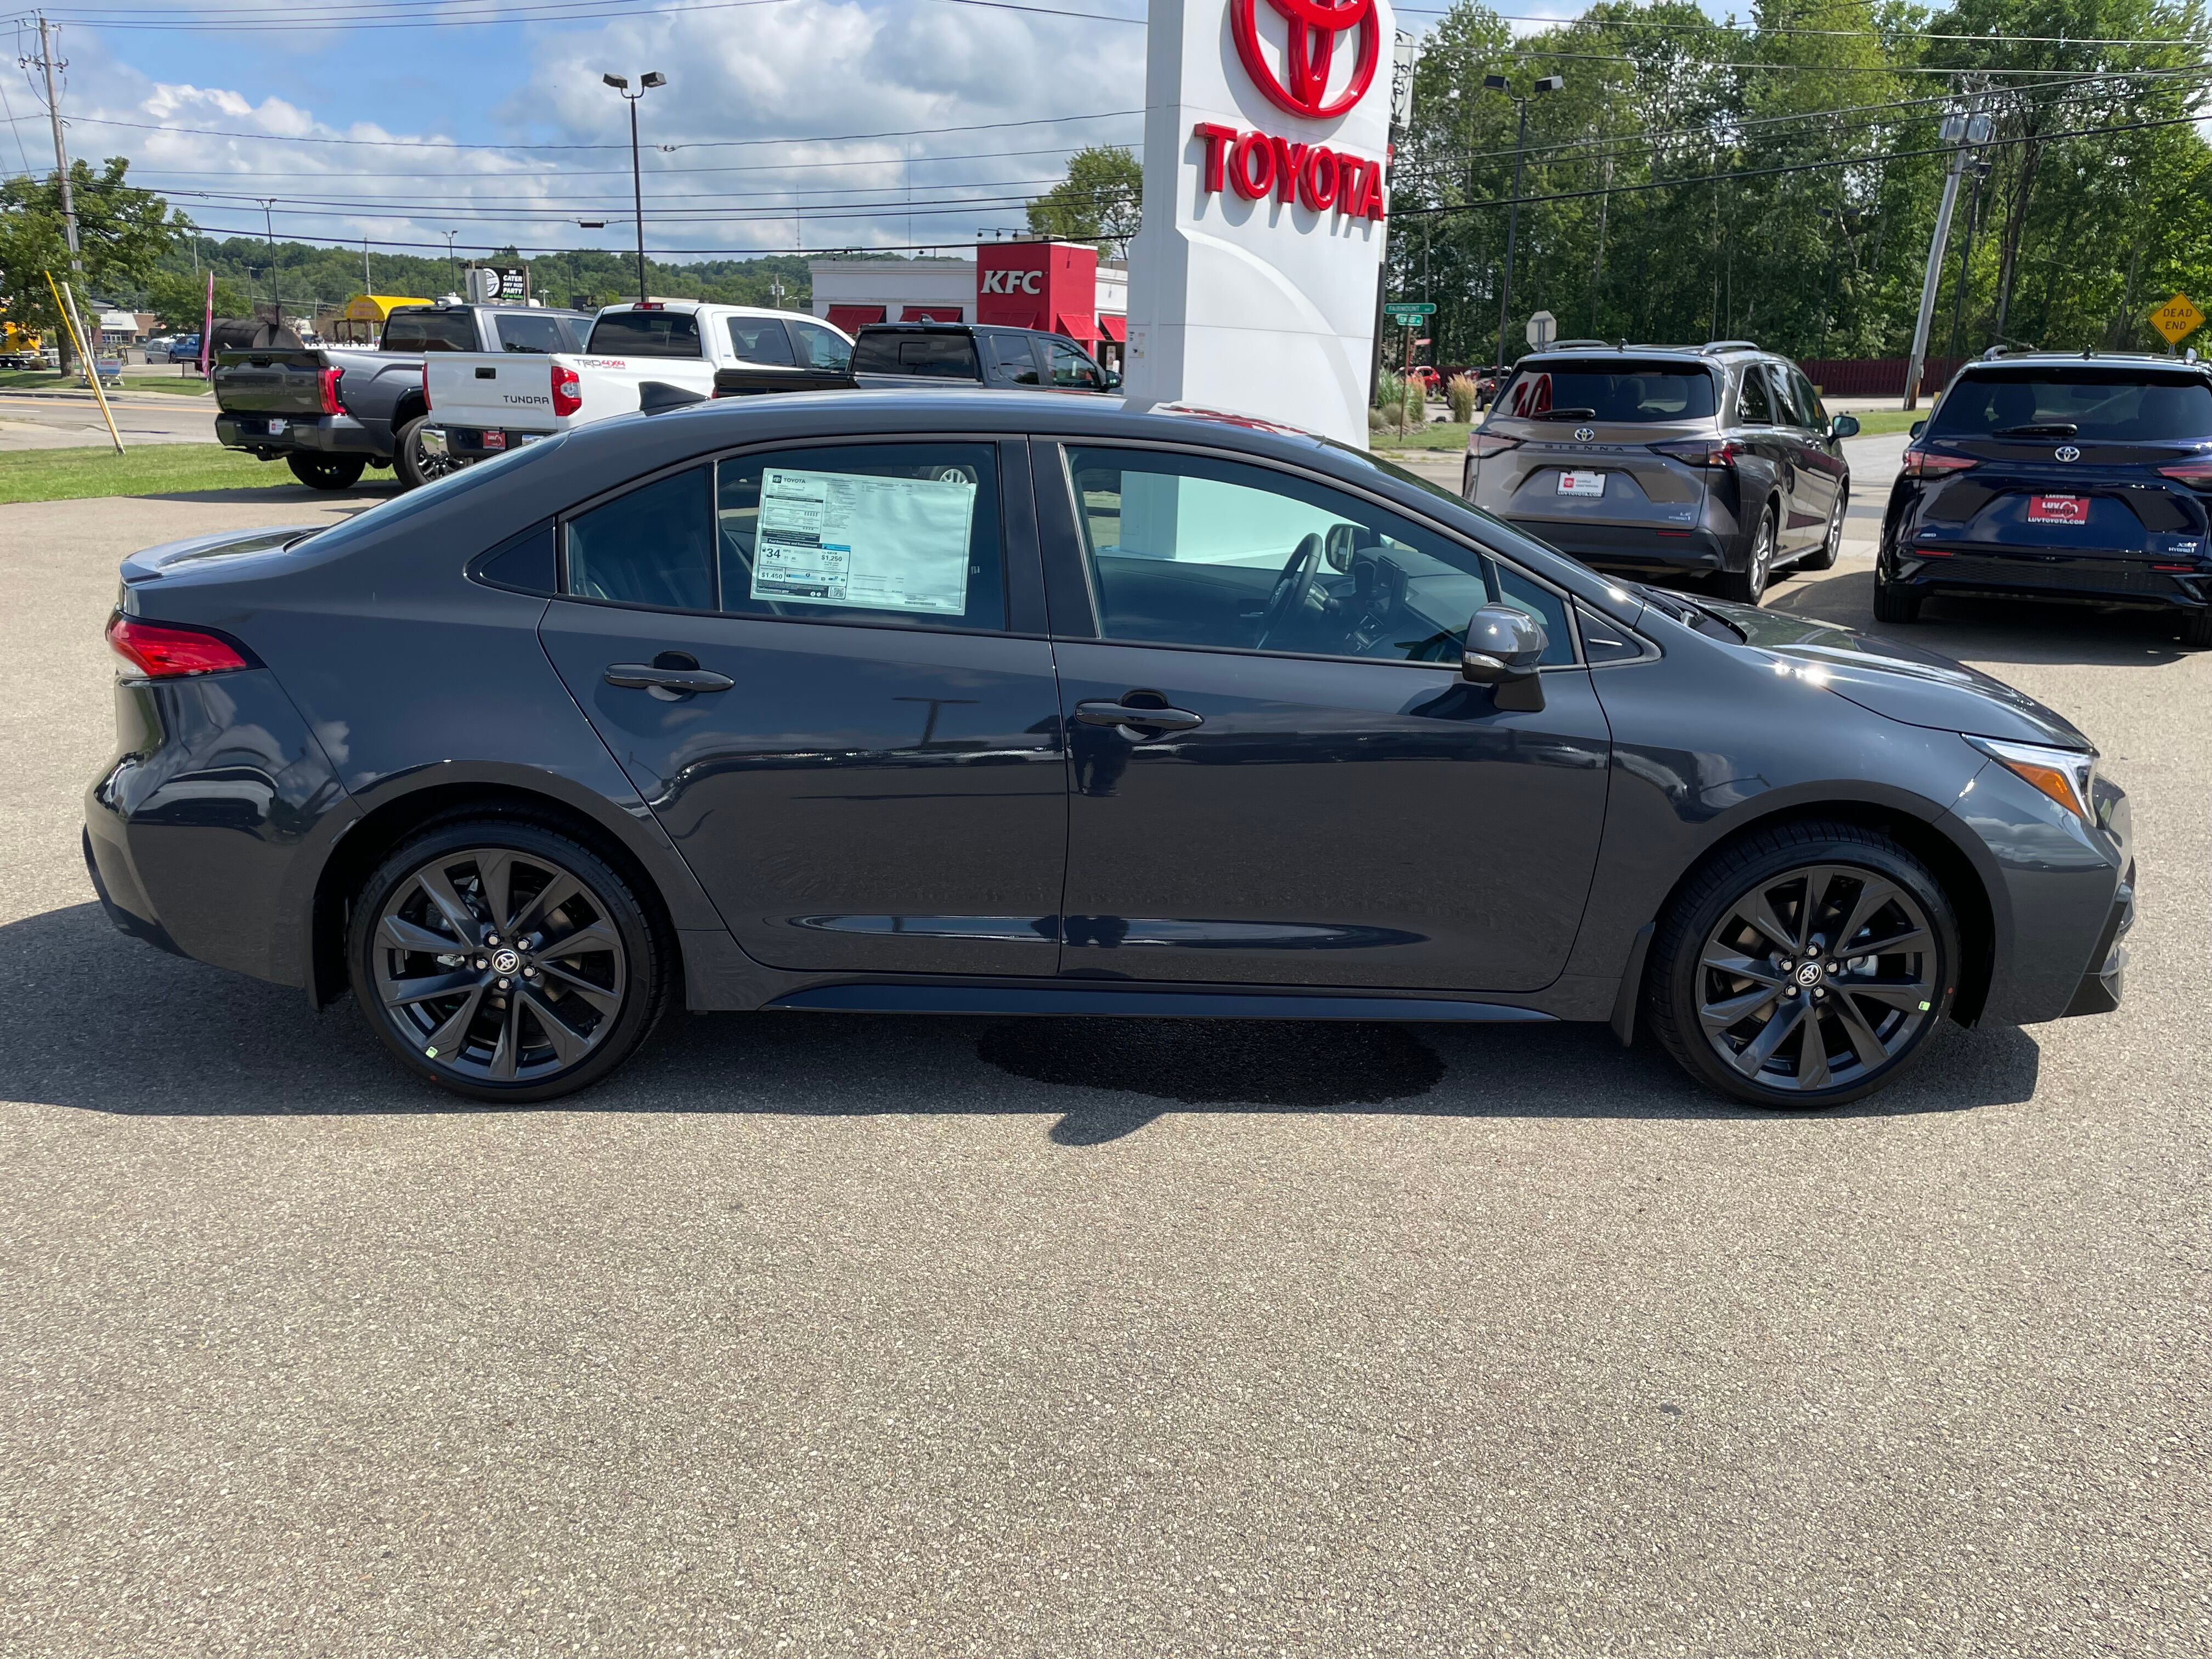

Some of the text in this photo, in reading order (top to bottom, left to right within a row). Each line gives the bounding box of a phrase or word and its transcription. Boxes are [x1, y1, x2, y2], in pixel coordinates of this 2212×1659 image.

[1194, 122, 1384, 221] TOYOTA
[980, 270, 1043, 295] KFC
[2163, 308, 2193, 317] DEAD
[2165, 321, 2186, 330] END
[503, 395, 549, 404] TUNDRA
[1544, 444, 1624, 452] SIENNA
[2028, 517, 2085, 525] LUVTOYOTA.COM
[766, 548, 781, 558] 34
